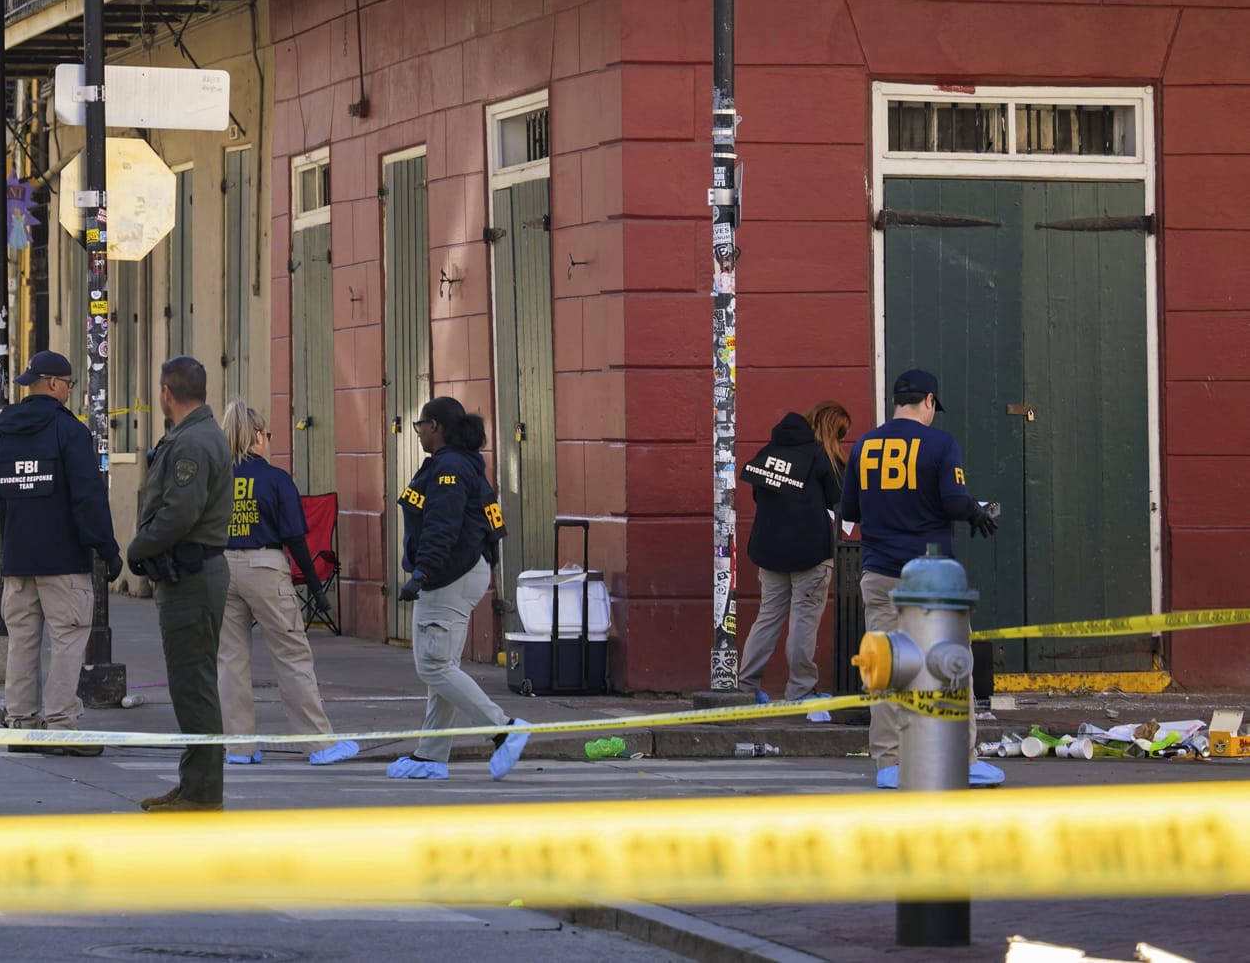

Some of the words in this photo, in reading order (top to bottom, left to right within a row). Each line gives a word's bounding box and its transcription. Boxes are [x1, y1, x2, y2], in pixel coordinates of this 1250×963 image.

[14, 460, 39, 474] FBI
[745, 464, 775, 479] EVIDENCE
[764, 455, 792, 475] FBI
[859, 438, 921, 490] FBI
[234, 477, 255, 500] BI
[438, 475, 456, 485] FBI
[765, 477, 781, 488] TEAM
[401, 487, 426, 510] FBI
[232, 512, 260, 524] PONSE
[483, 502, 504, 531] FB
